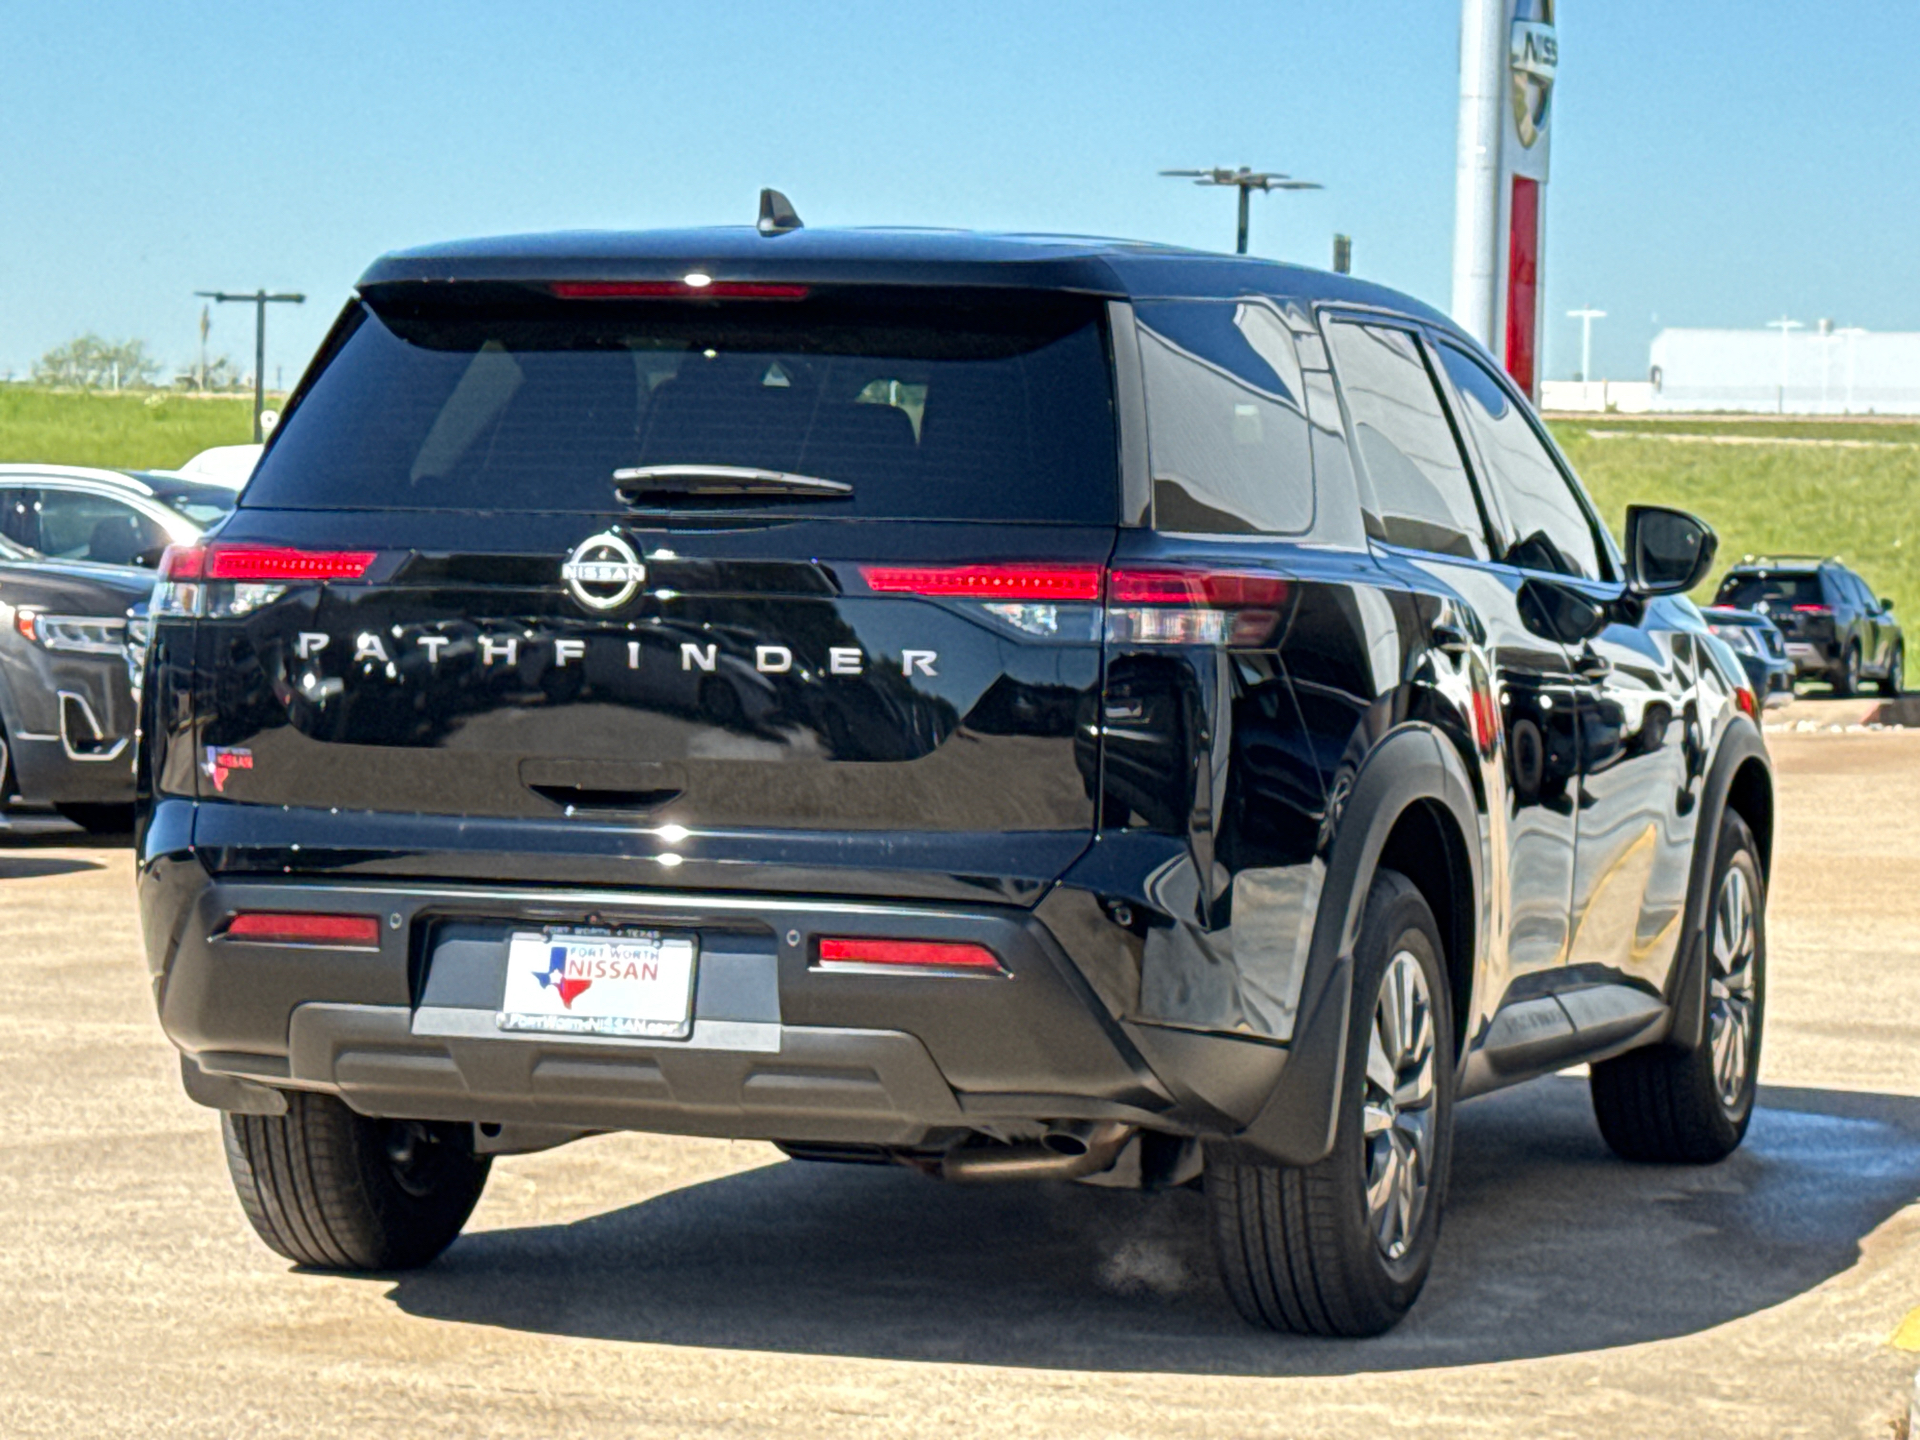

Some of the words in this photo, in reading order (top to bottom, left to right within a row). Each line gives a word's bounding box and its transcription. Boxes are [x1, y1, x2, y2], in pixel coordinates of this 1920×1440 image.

[564, 565, 644, 581] NISSAN
[299, 632, 938, 676] PATHFINDER
[574, 926, 611, 936] WORTH
[626, 928, 660, 939] TEXAS
[570, 947, 604, 958] FORT
[610, 948, 660, 961] WORTH
[568, 959, 660, 981] NISSAN
